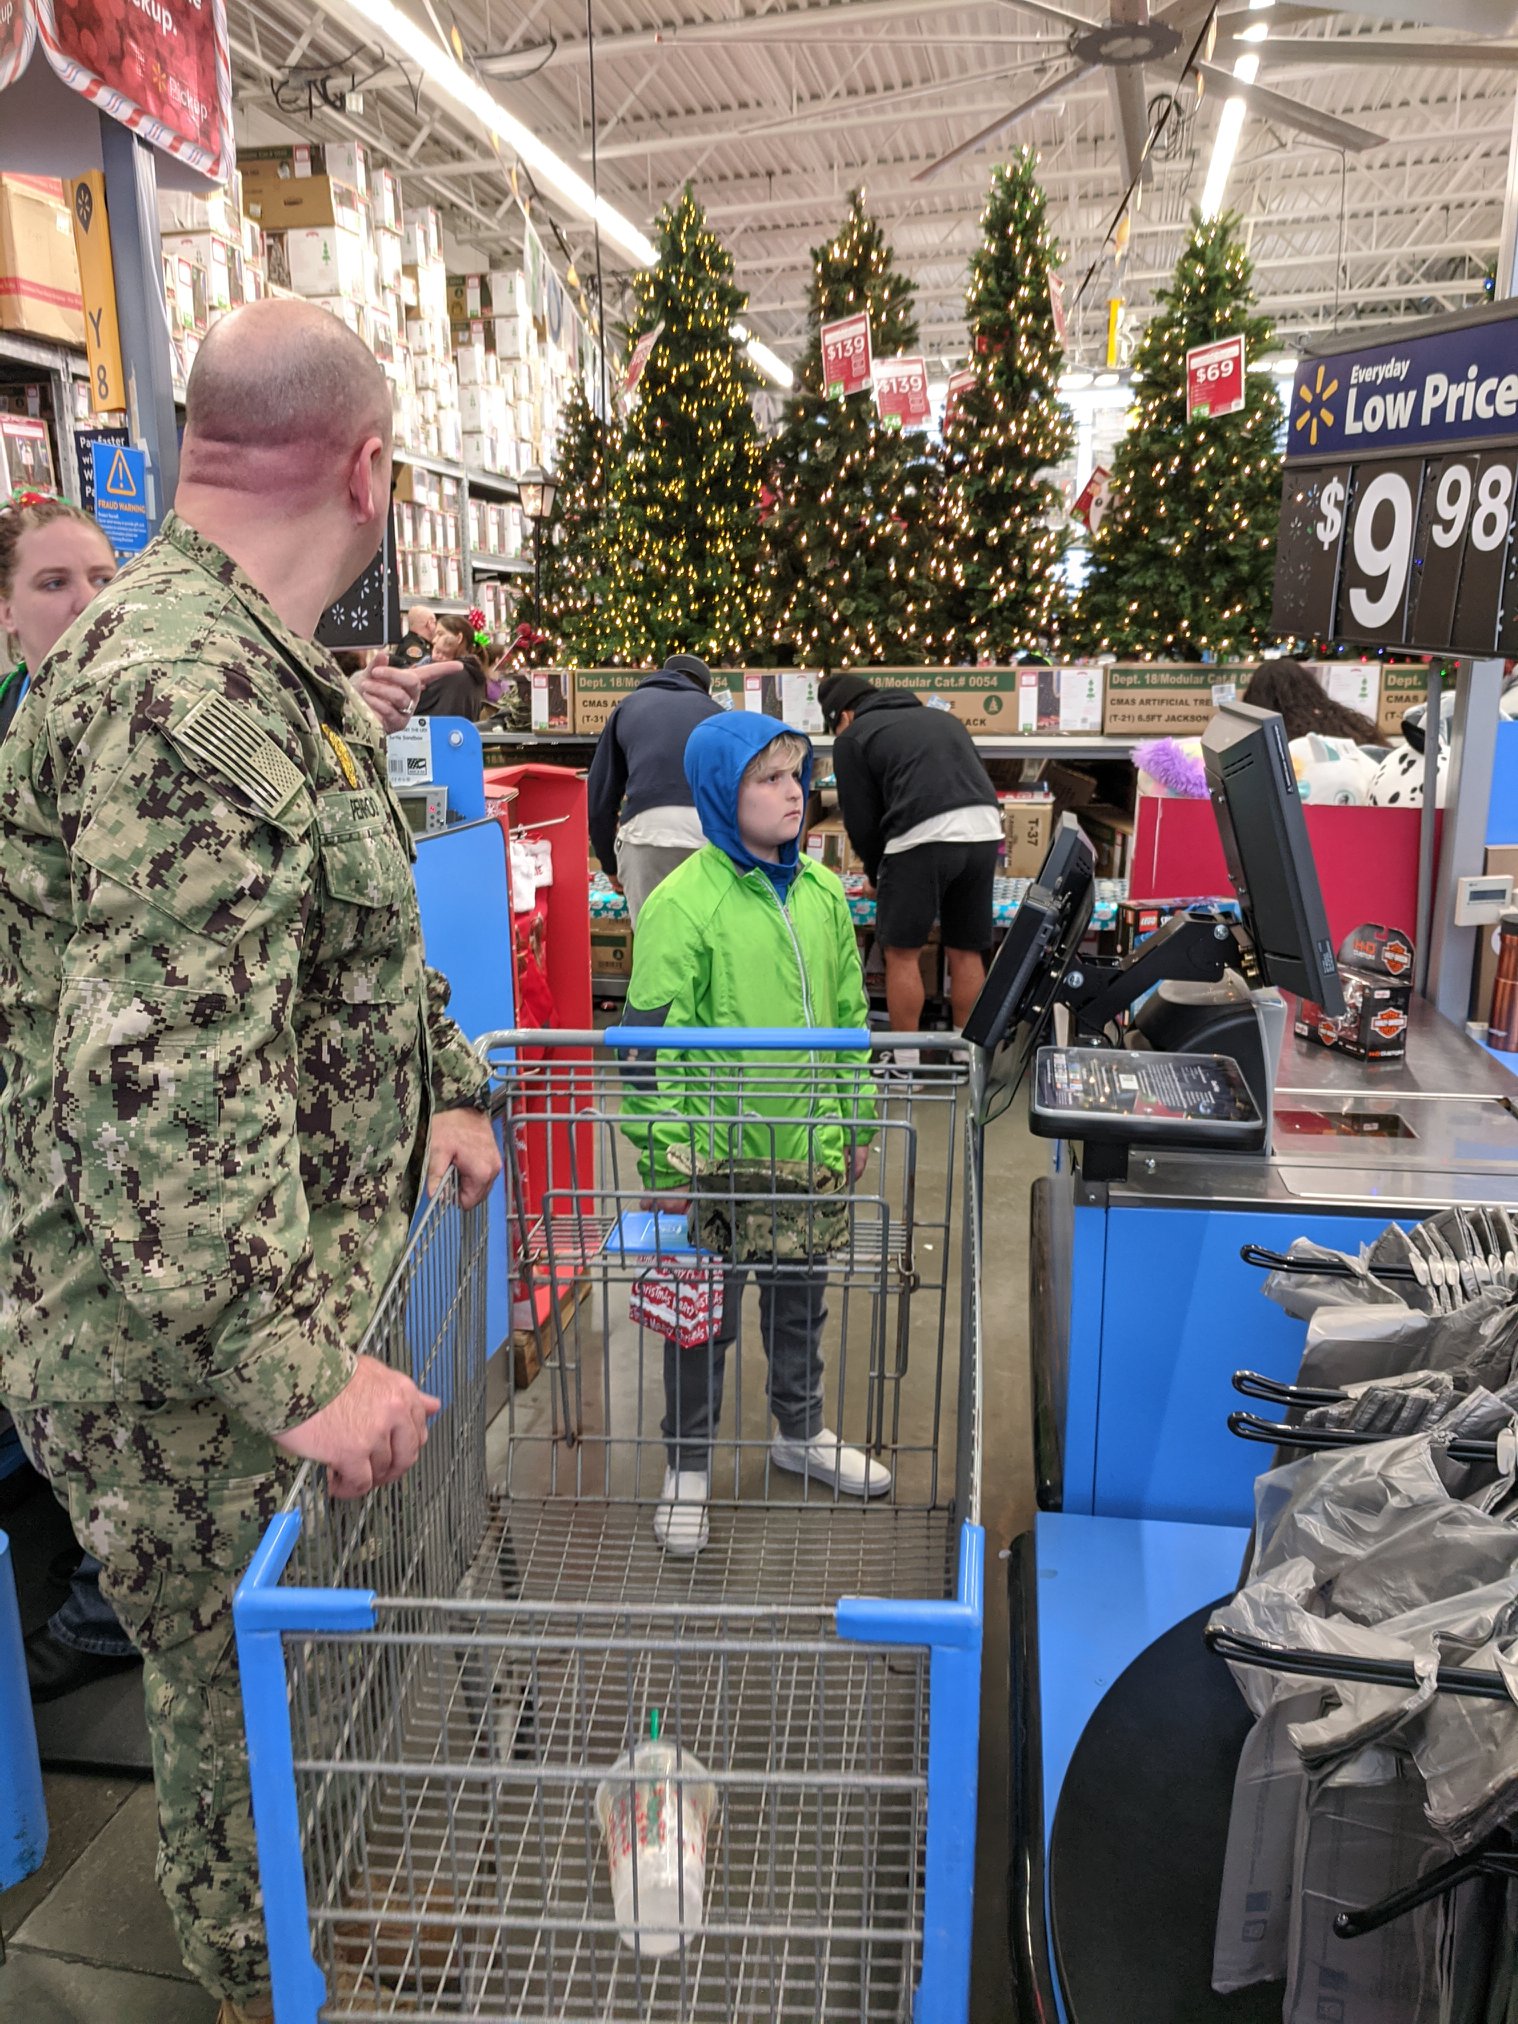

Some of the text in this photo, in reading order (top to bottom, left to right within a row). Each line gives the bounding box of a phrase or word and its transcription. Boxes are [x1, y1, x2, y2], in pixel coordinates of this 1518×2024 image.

[169, 75, 208, 123] Pickup
[88, 307, 110, 401] Y 8
[827, 335, 866, 361] $139
[1196, 359, 1235, 384] $69
[1349, 357, 1411, 386] Everyday
[880, 375, 923, 395] $139
[1344, 386, 1417, 436] Low
[98, 499, 146, 514] FRAUD WARNING
[579, 676, 607, 689] Dept.
[609, 675, 640, 688] 18/Mo
[934, 675, 966, 688] Cat.#
[969, 675, 998, 688] 0054
[1112, 673, 1141, 687] Dept.
[1144, 672, 1204, 685] 18/Modular
[1207, 672, 1237, 686] Cat.#
[1387, 674, 1422, 689] Dept.
[582, 699, 609, 709] CMAS
[1110, 697, 1210, 707] CMAS ARTIFICIAL TRE
[1386, 694, 1419, 704] CMAS
[1137, 714, 1163, 723] 6.5FT
[1164, 713, 1209, 723] JACKSON
[1027, 817, 1040, 848] T-37
